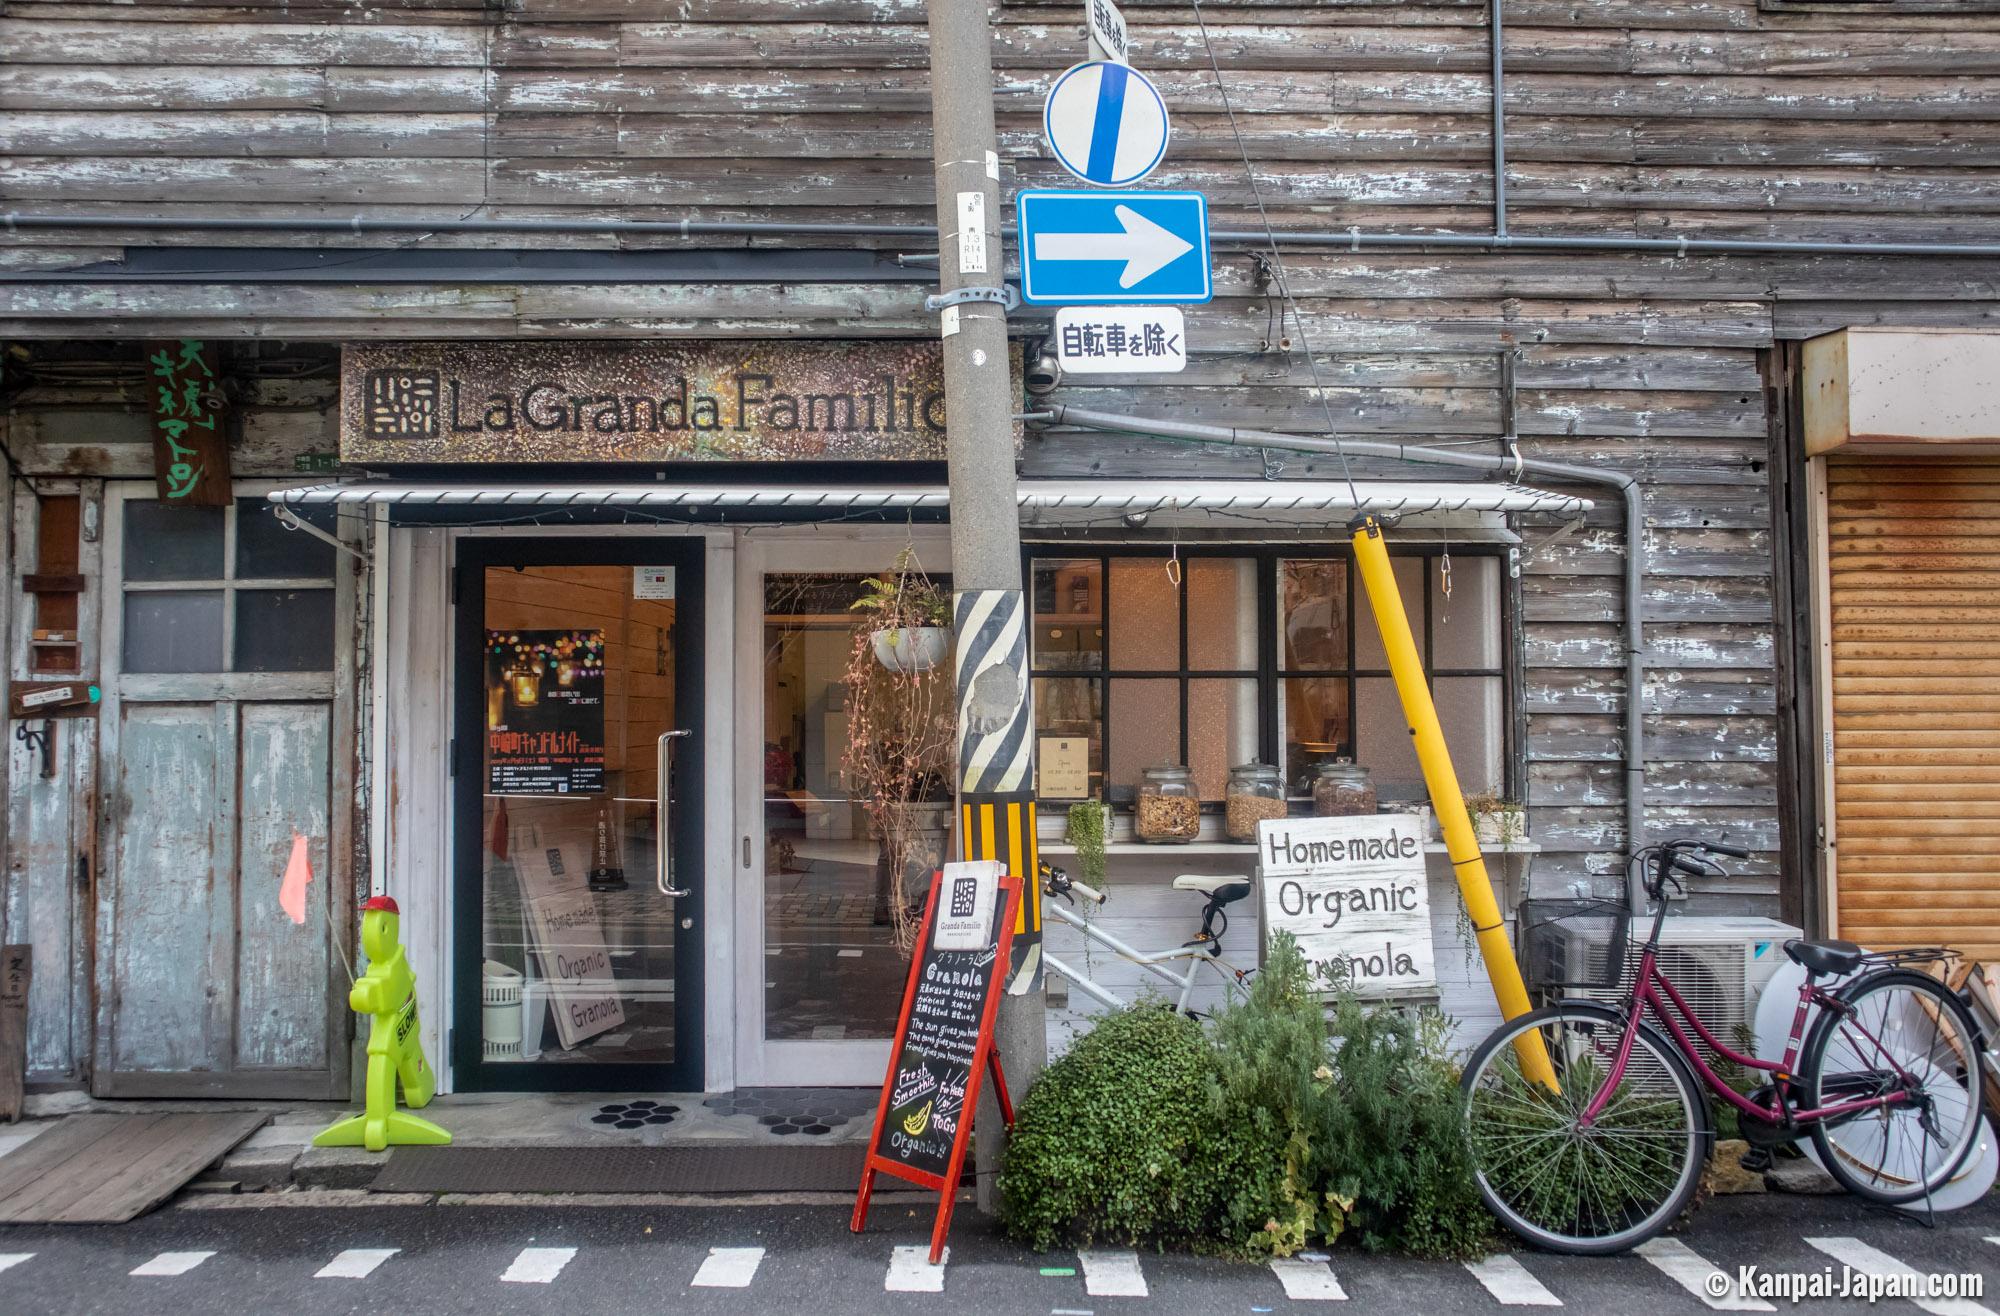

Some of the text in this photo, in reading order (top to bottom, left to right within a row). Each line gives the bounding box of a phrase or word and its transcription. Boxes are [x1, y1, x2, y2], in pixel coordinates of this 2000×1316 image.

[1062, 323, 1181, 358] 自転車を除く
[1269, 828, 1418, 865] Homemade
[1279, 881, 1418, 929] Organic
[556, 951, 606, 986] Organic
[926, 962, 983, 988] Granola
[937, 951, 974, 966] グラノーラ
[1296, 942, 1420, 980] ranola
[570, 994, 620, 1029] Granola
[912, 1018, 924, 1029] The
[938, 1025, 958, 1036] gives
[891, 1075, 935, 1106] Smoothie
[899, 1061, 928, 1087] Fresh
